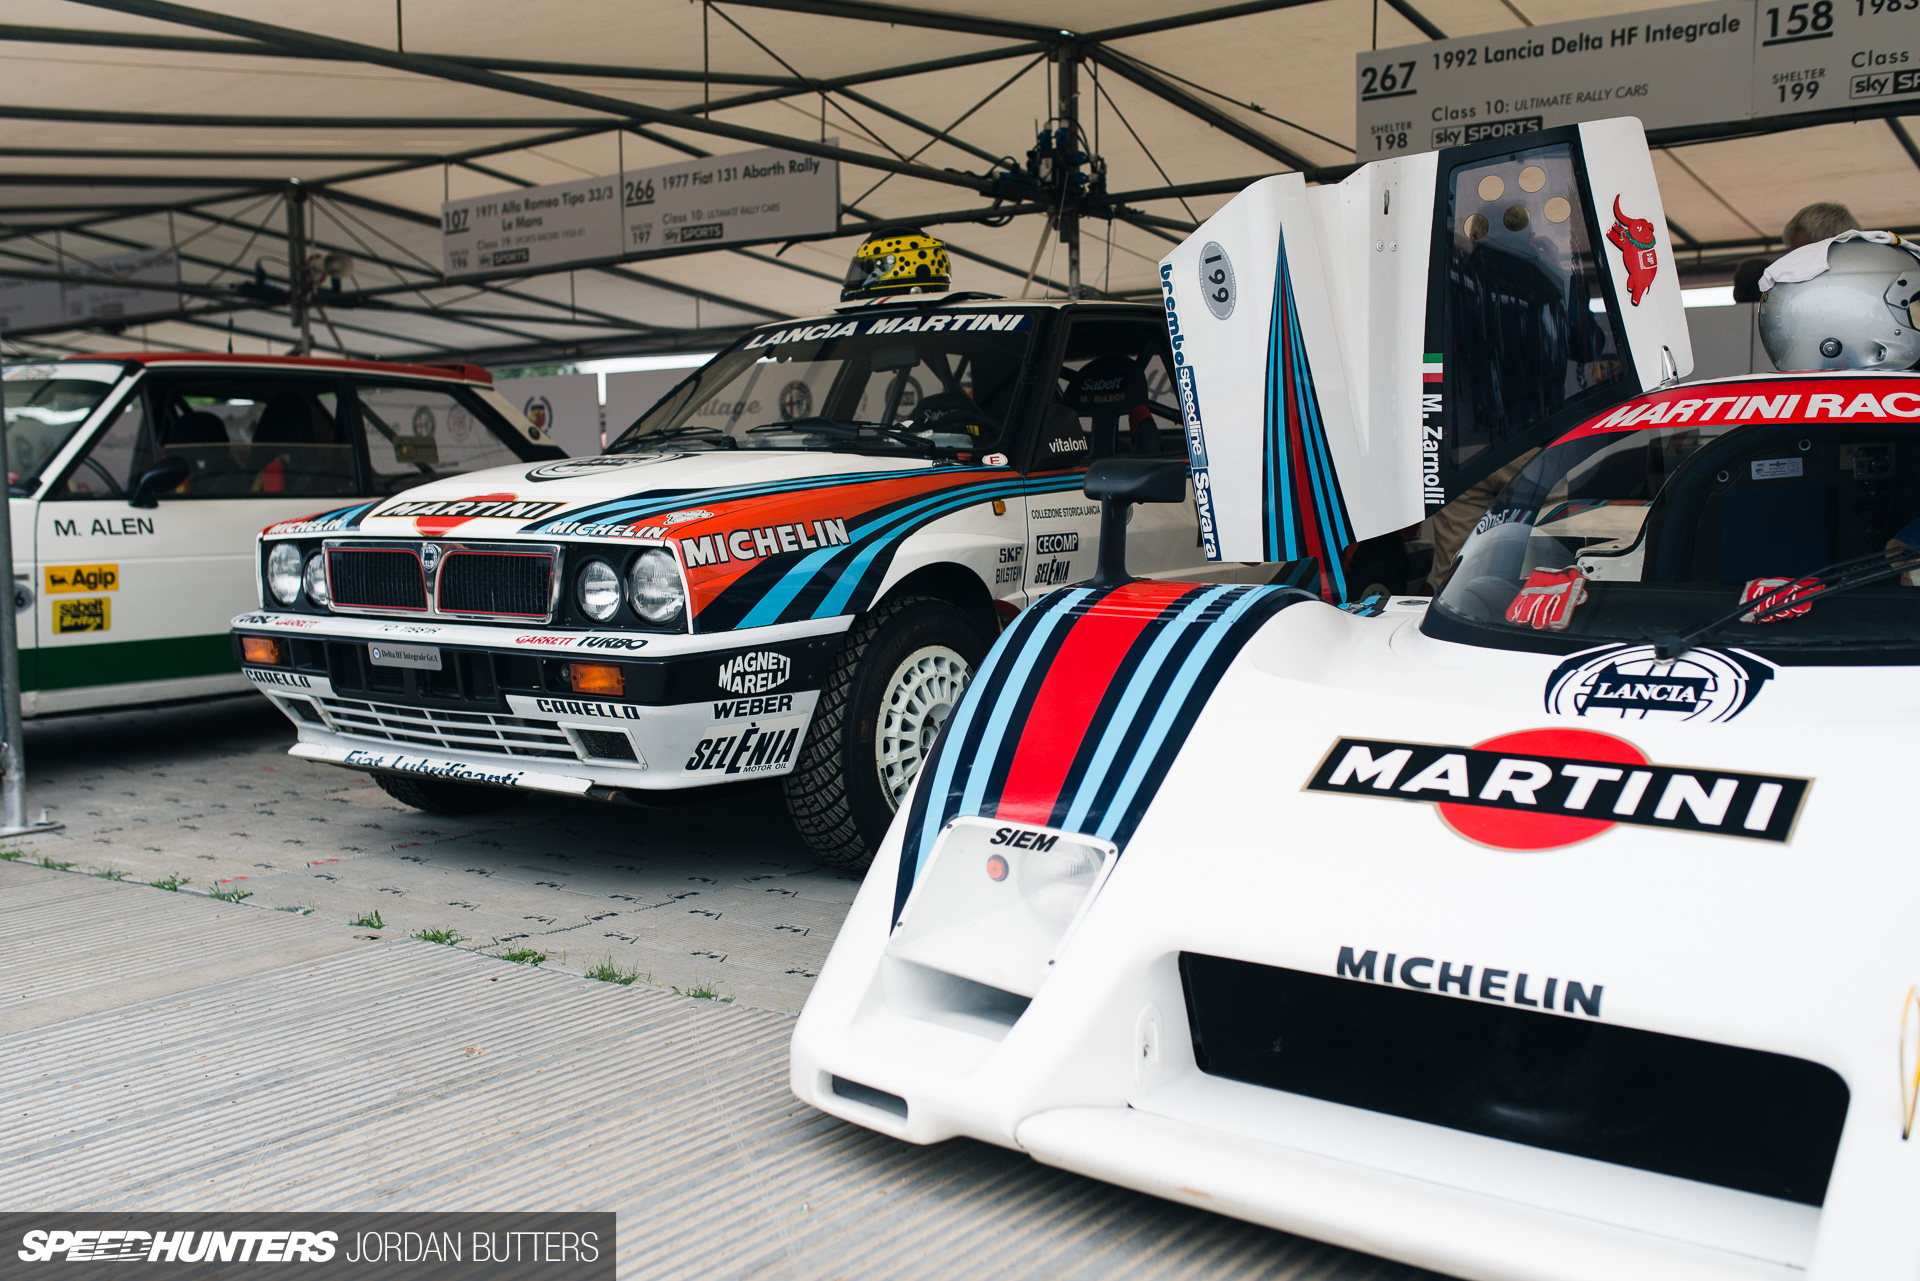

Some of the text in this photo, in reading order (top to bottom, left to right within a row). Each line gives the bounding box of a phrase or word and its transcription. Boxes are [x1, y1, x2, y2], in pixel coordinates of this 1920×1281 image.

[1766, 0, 1833, 38] 158
[1433, 14, 1741, 70] 1992 Lancia Delta HF Integrale
[1851, 50, 1910, 68] Class
[1361, 60, 1417, 95] 267
[1772, 68, 1826, 84] SHELTER
[1854, 76, 1890, 94] sky
[1432, 83, 1650, 122] Class 10: ULTIMATE RALLY CARS
[1778, 80, 1820, 103] 199
[1370, 121, 1413, 135] SHELTER
[1435, 119, 1540, 146] sky SPORTS
[1375, 132, 1408, 151] 198
[662, 157, 820, 190] 1977 Fiat 131 Abarth Rally
[625, 178, 655, 202] 266
[524, 196, 560, 211] Romeo
[444, 208, 470, 231] 107
[515, 215, 544, 229] Mans
[662, 213, 688, 225] Class
[632, 231, 651, 244] 197
[1204, 254, 1229, 303] 199
[1160, 263, 1185, 367] brembo
[743, 314, 1026, 350] LANCIA MARTINI
[1179, 367, 1203, 456] speedline
[1592, 392, 1920, 429] MARTINI RAC
[1049, 436, 1088, 454] vitaloni
[1422, 394, 1445, 504] M. Zarnolli
[990, 455, 1002, 465] E
[380, 502, 557, 518] MARTINI
[1031, 505, 1102, 520] COLLEZIONE STORICA LANCIA
[1194, 472, 1218, 558] Savara
[54, 516, 155, 536] M. ALEN
[266, 518, 348, 535] MICHELIN
[545, 520, 670, 540] MICHELIN
[680, 518, 851, 569] MICHELIN
[998, 546, 1022, 564] SKF
[1038, 534, 1078, 553] CECOMP
[72, 567, 116, 590] Agip
[996, 564, 1022, 584] BILSTEIN
[515, 635, 648, 650] GARRETT TURBO
[245, 668, 312, 689] CARELLO
[718, 652, 790, 685] MAGNETI
[718, 664, 790, 694] MARELLI
[1594, 681, 1698, 704] LANCIA
[536, 698, 640, 720] CARELLO
[713, 694, 793, 720] WEBER
[743, 762, 788, 773] MOTOR OIL
[1327, 745, 1783, 832] MARTINI
[990, 827, 1060, 853] SIEM
[1336, 946, 1604, 1018] MICHELIN
